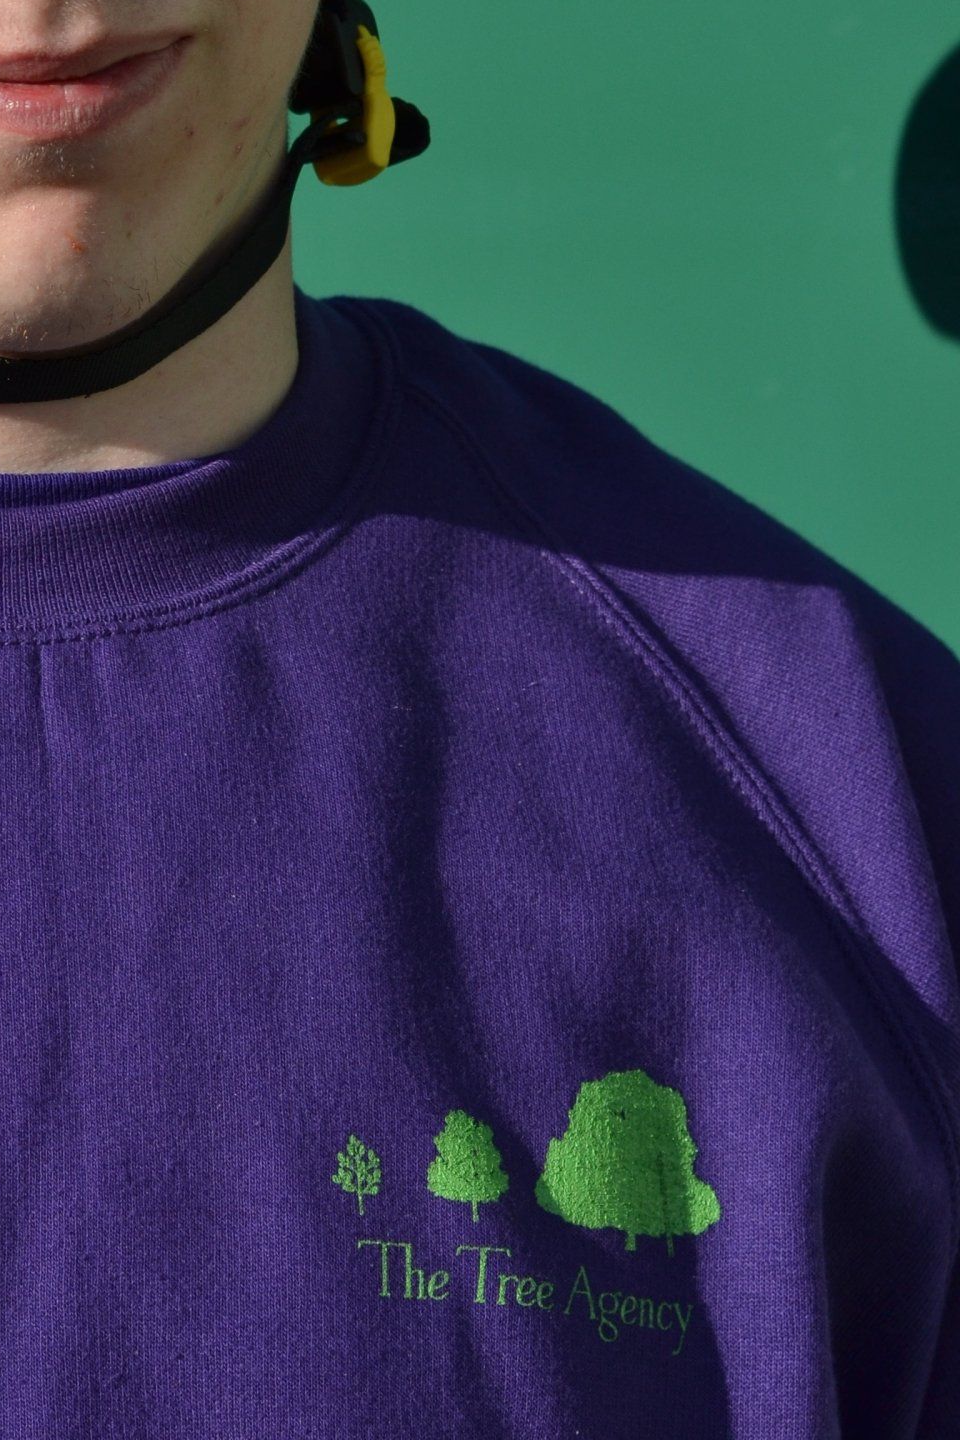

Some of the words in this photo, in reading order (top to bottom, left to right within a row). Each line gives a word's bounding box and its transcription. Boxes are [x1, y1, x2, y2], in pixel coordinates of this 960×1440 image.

[357, 1239, 451, 1301] The
[456, 1244, 555, 1312] Tree
[563, 1265, 694, 1357] Agency
